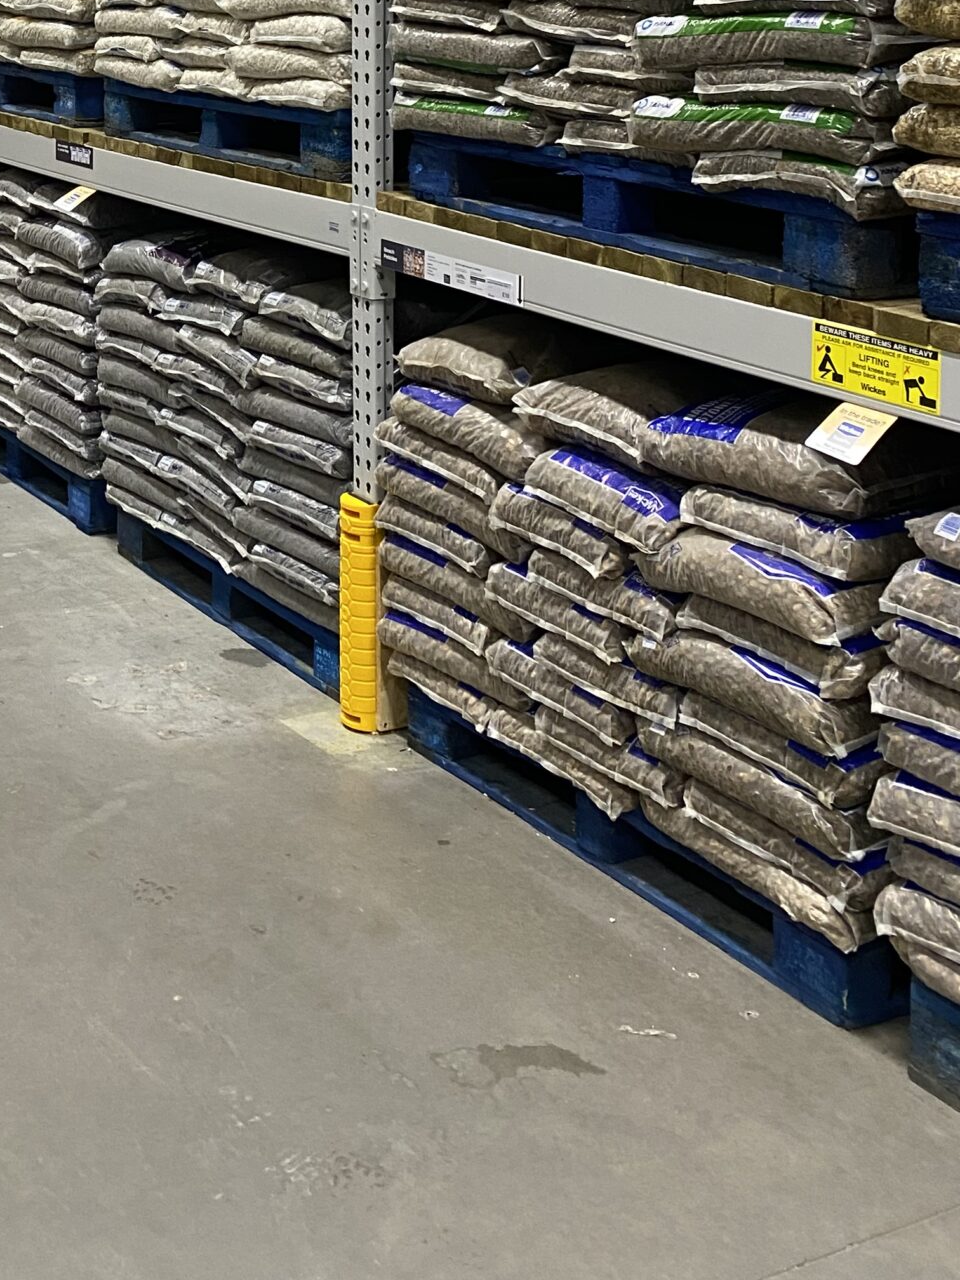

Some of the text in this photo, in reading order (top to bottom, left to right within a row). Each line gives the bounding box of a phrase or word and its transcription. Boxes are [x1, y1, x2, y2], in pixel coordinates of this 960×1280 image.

[819, 325, 934, 359] BEWARE THESE ITEMS ARE HEAVY
[822, 335, 841, 345] PLEASE
[853, 342, 864, 350] FOR
[864, 345, 896, 358] ASSISTANCE
[902, 354, 930, 367] REQUIRED
[852, 361, 897, 379] Bend knees and
[859, 354, 890, 368] LIFTING
[848, 367, 900, 386] keep back straight
[860, 382, 887, 397] Wickes
[848, 411, 860, 419] the
